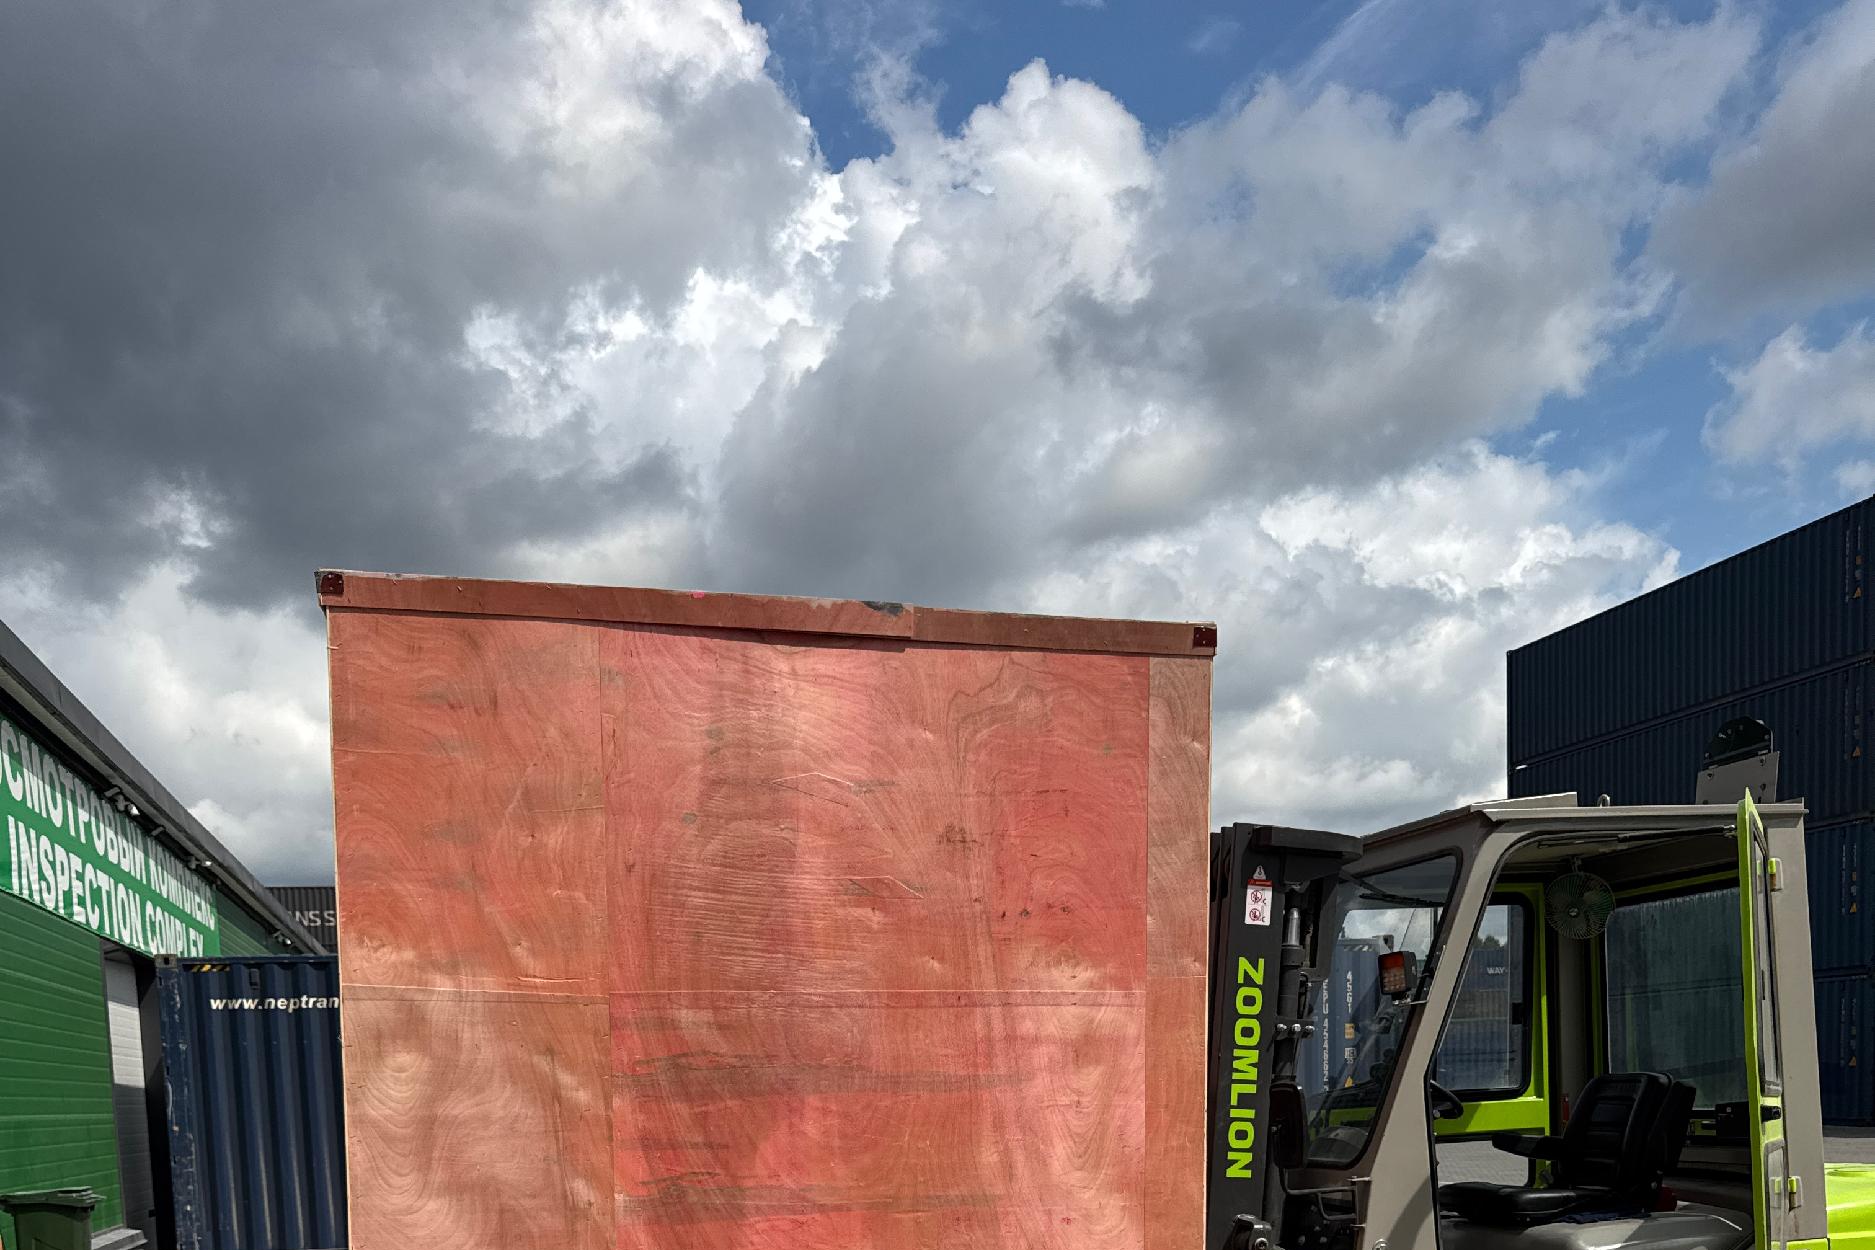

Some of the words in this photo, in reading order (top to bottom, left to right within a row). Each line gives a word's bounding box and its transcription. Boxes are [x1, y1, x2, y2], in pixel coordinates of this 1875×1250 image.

[0, 720, 147, 885] СМОТРОВЫЙ
[7, 814, 145, 953] INSPECTION
[209, 994, 340, 1014] www.neptran
[1225, 957, 1265, 1179] ZOOMLION
